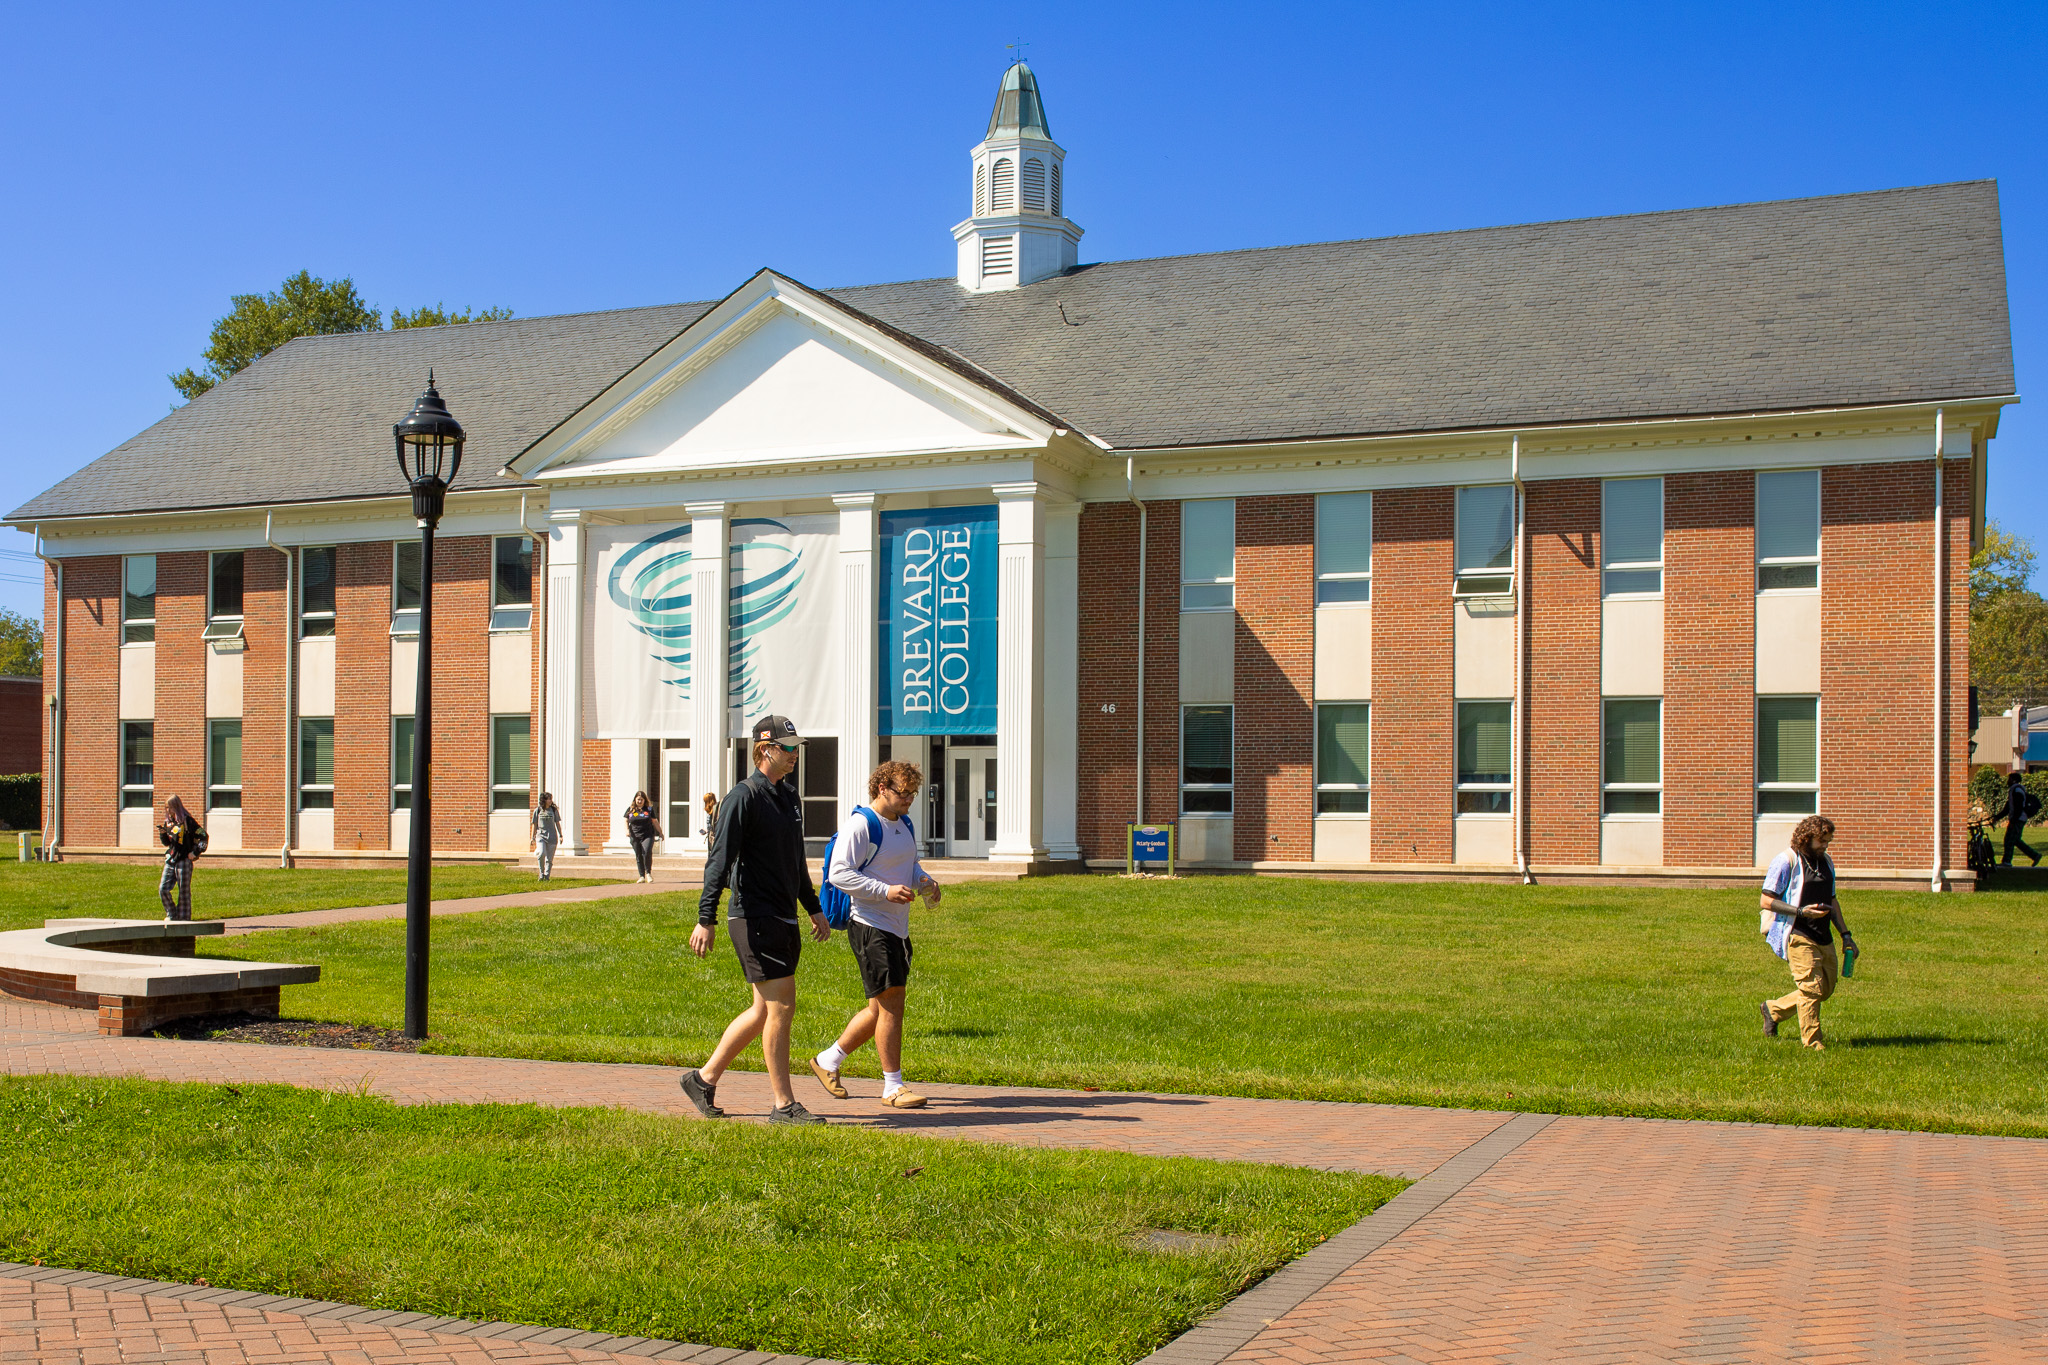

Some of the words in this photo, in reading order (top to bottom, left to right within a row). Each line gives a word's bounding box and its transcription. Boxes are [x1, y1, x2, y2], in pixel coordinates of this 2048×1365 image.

[903, 528, 938, 715] BREVARD
[940, 526, 970, 715] COLLEGE
[1101, 703, 1116, 713] 46
